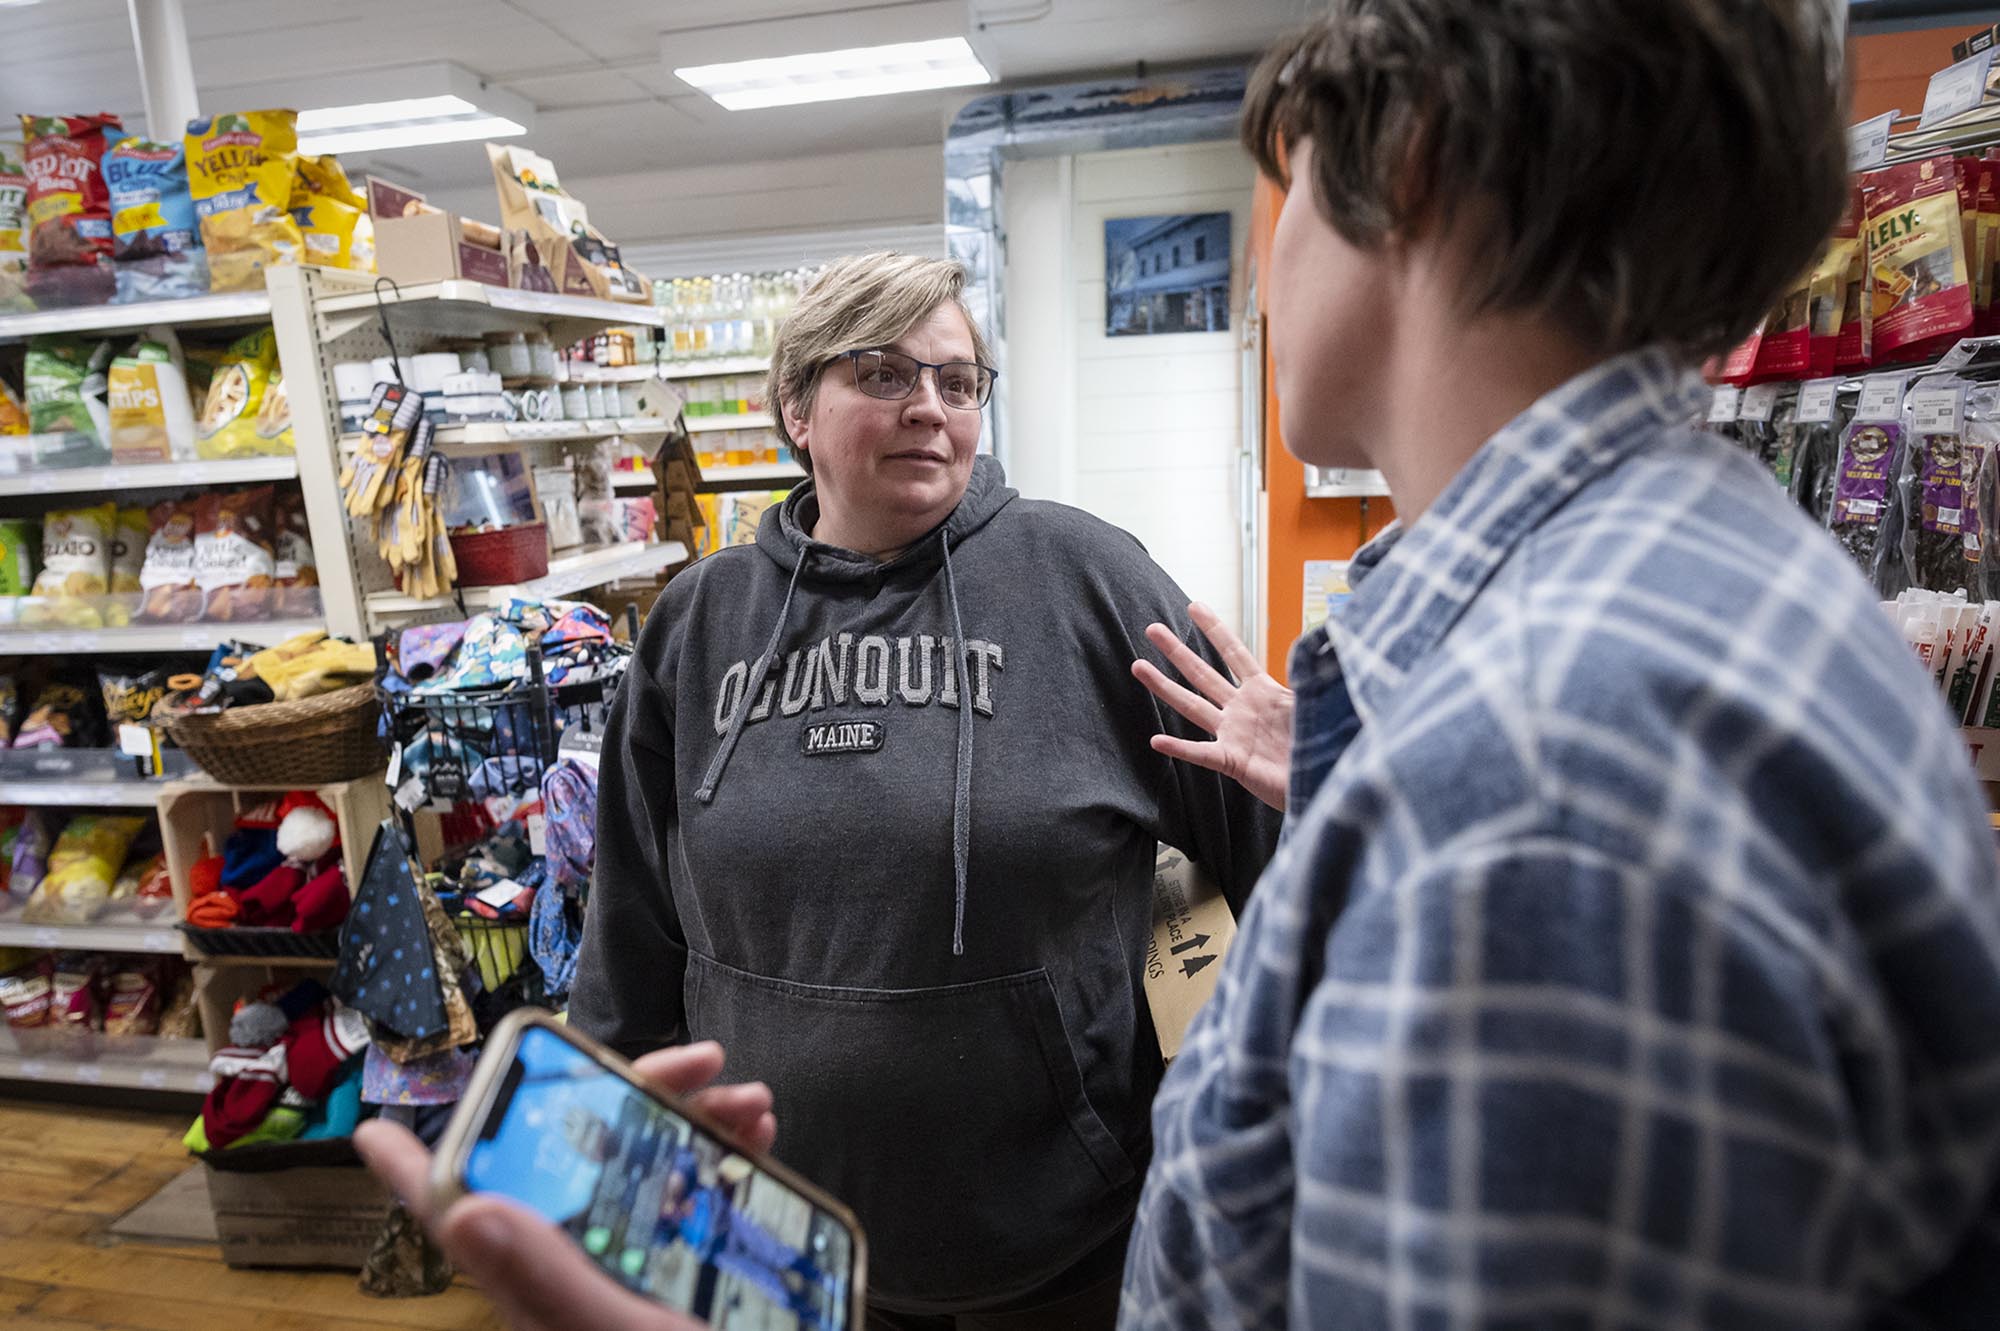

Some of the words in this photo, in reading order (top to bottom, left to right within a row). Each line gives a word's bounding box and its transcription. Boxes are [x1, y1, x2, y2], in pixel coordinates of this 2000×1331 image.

[713, 632, 1003, 737] OGUNQUIT
[807, 724, 876, 750] MAINE
[1166, 912, 1183, 943] PLACE
